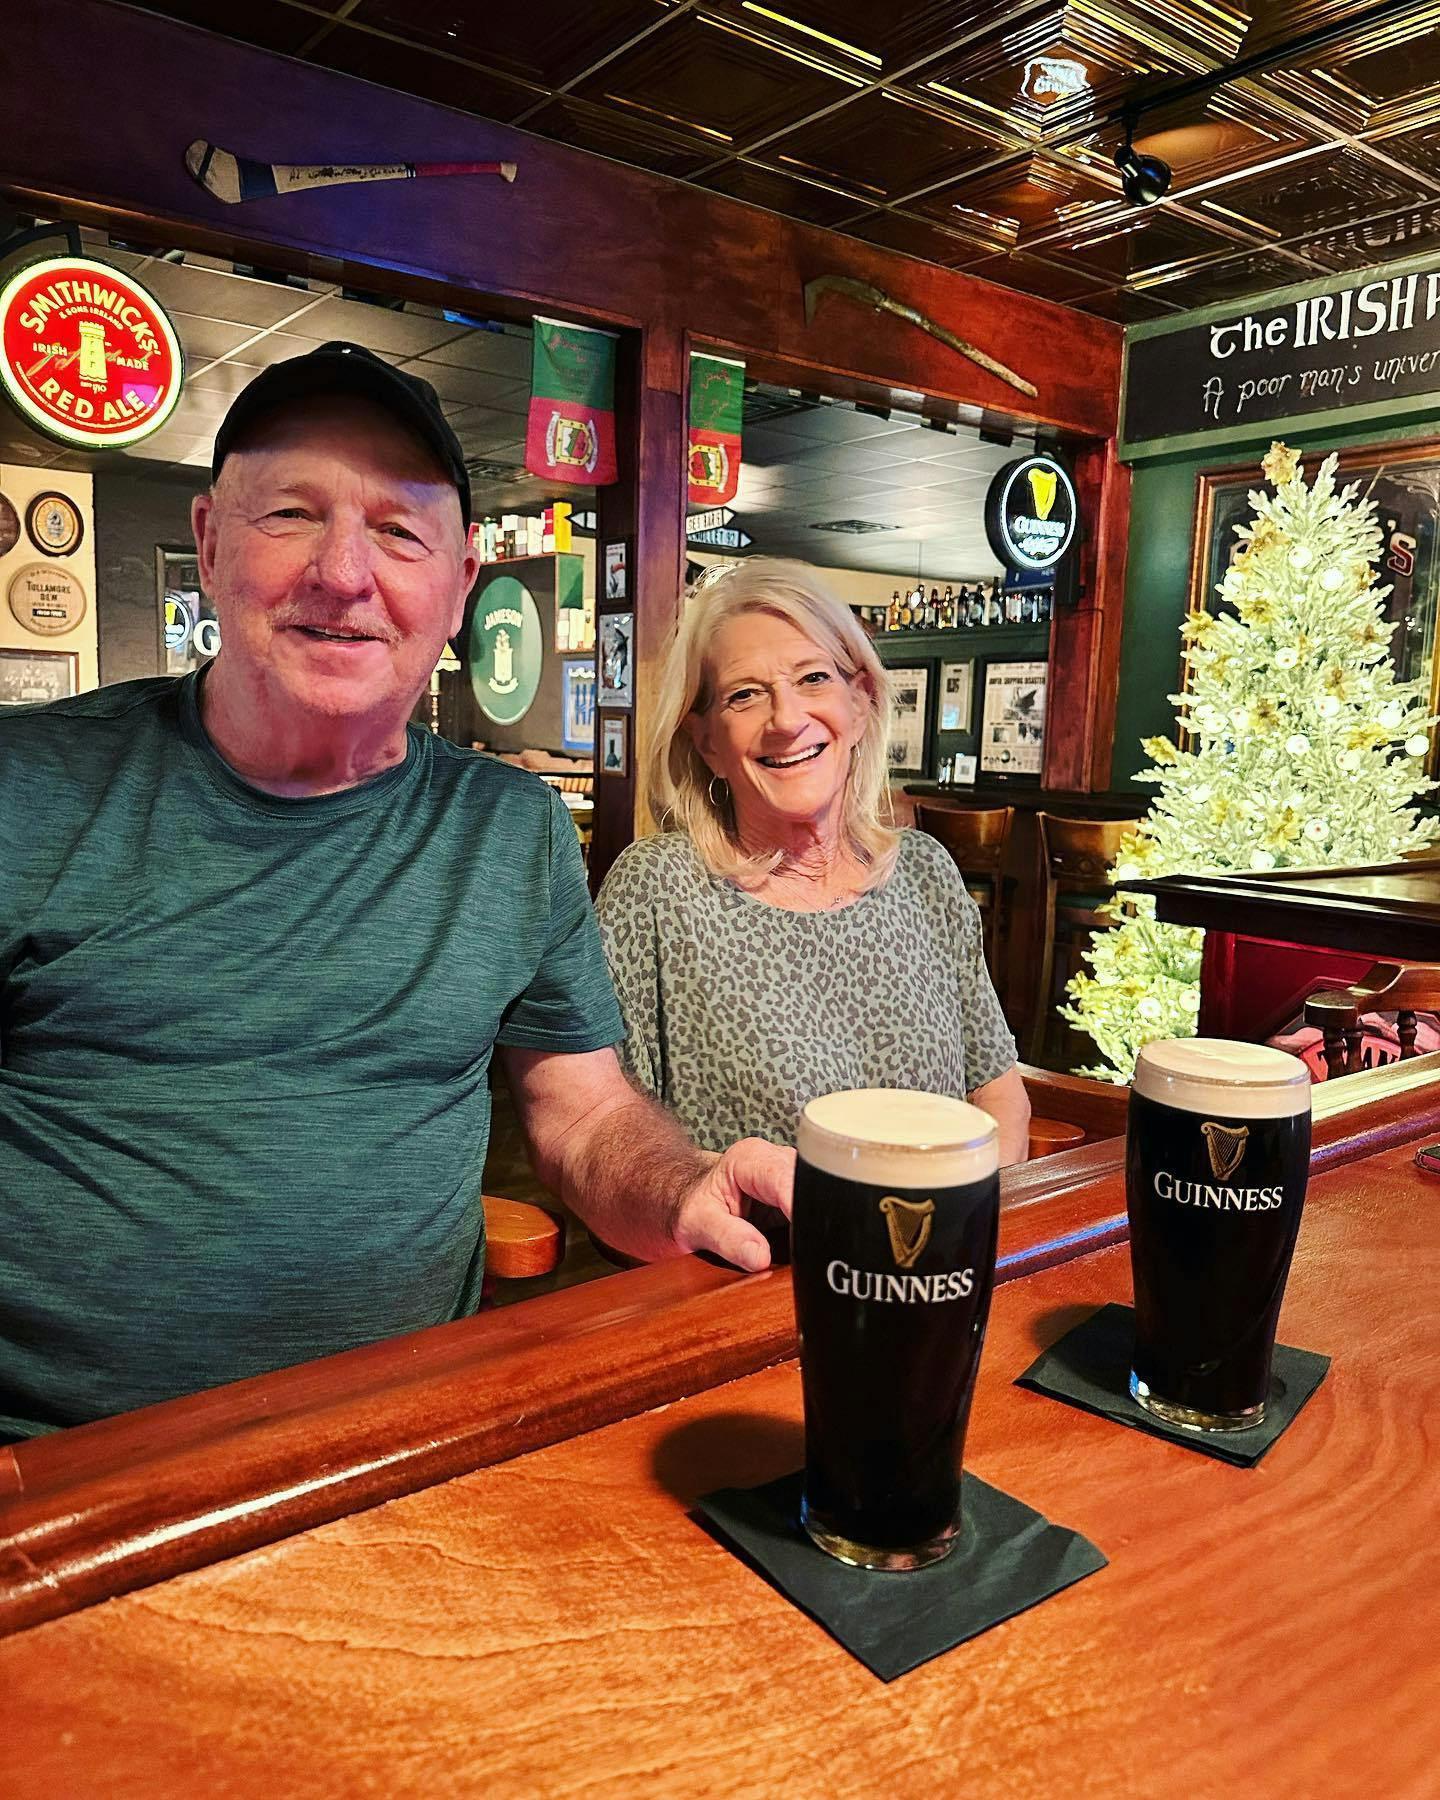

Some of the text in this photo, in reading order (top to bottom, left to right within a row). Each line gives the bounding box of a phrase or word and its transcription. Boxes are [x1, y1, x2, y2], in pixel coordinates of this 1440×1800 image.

[1210, 316, 1288, 359] The
[1293, 273, 1419, 349] IRISH
[33, 342, 150, 371] IRISH MADE
[39, 377, 94, 419] RED
[103, 390, 146, 421] ALE
[1203, 376, 1224, 420] A
[1236, 375, 1292, 414] poor
[1300, 364, 1363, 396] man's
[1154, 1171, 1284, 1212] GUINNESS
[826, 1259, 974, 1304] GUINNESS
